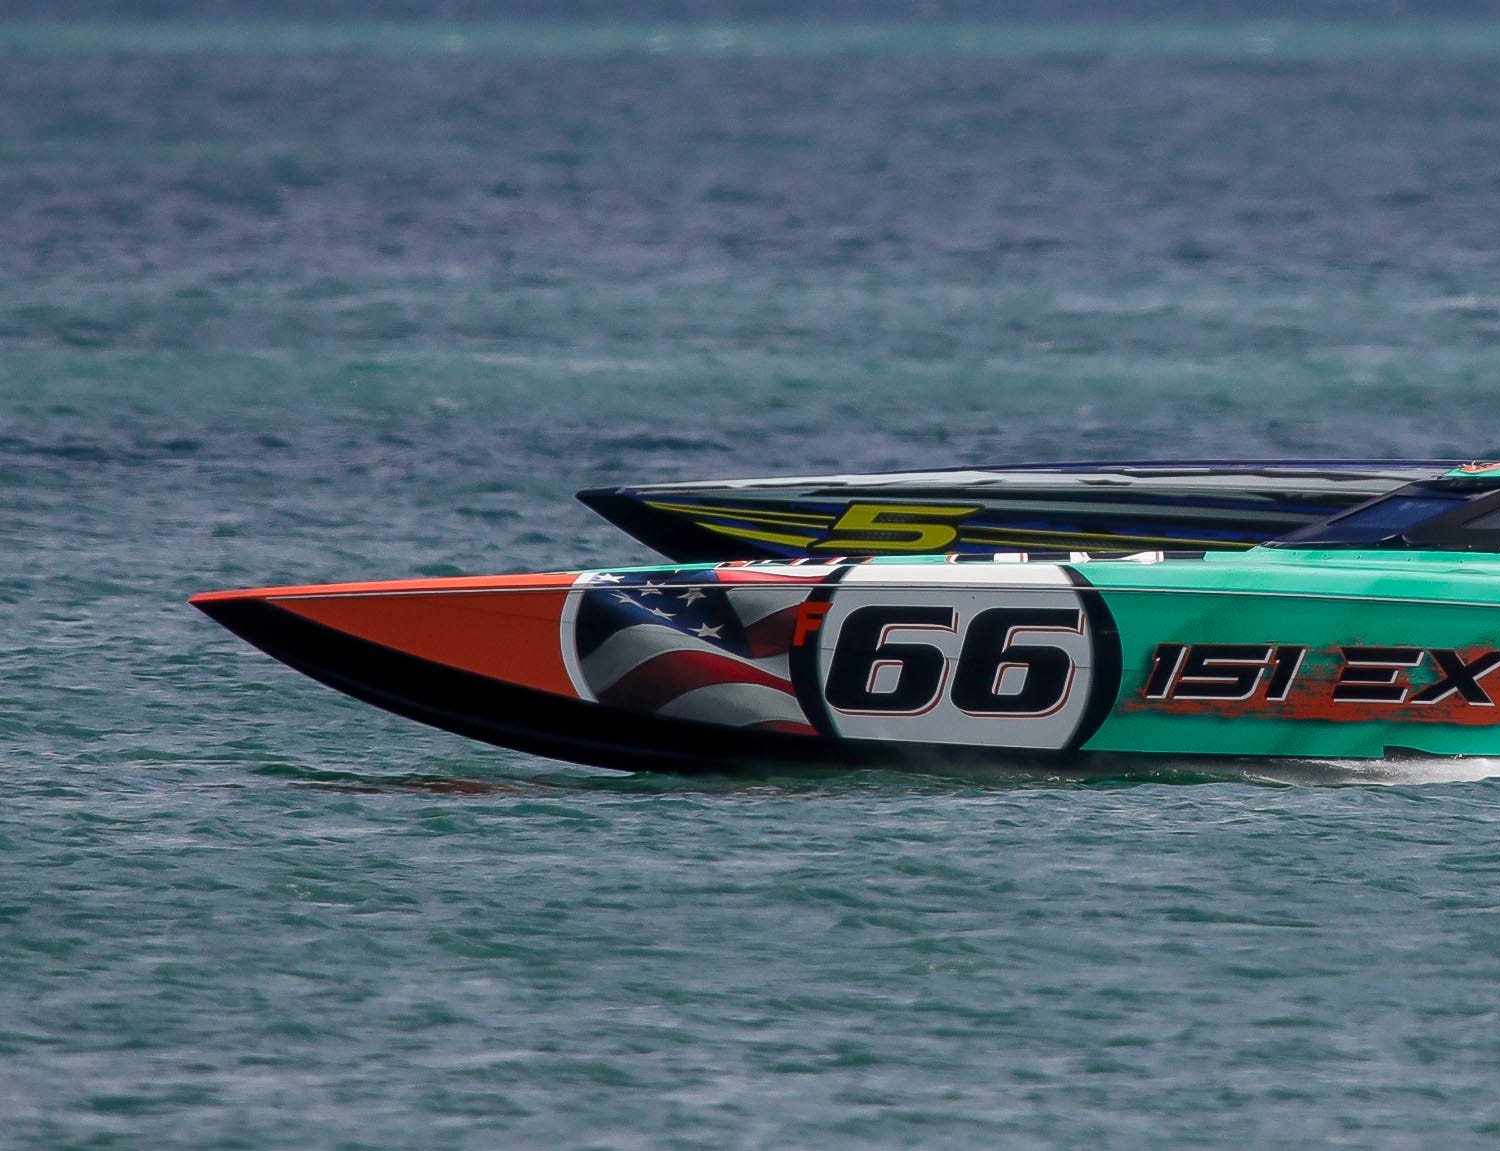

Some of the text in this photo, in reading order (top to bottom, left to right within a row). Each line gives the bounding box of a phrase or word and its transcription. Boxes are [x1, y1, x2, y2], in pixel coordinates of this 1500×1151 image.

[815, 502, 982, 552] 5
[793, 601, 1086, 719] F 66
[1143, 643, 1306, 701] 151
